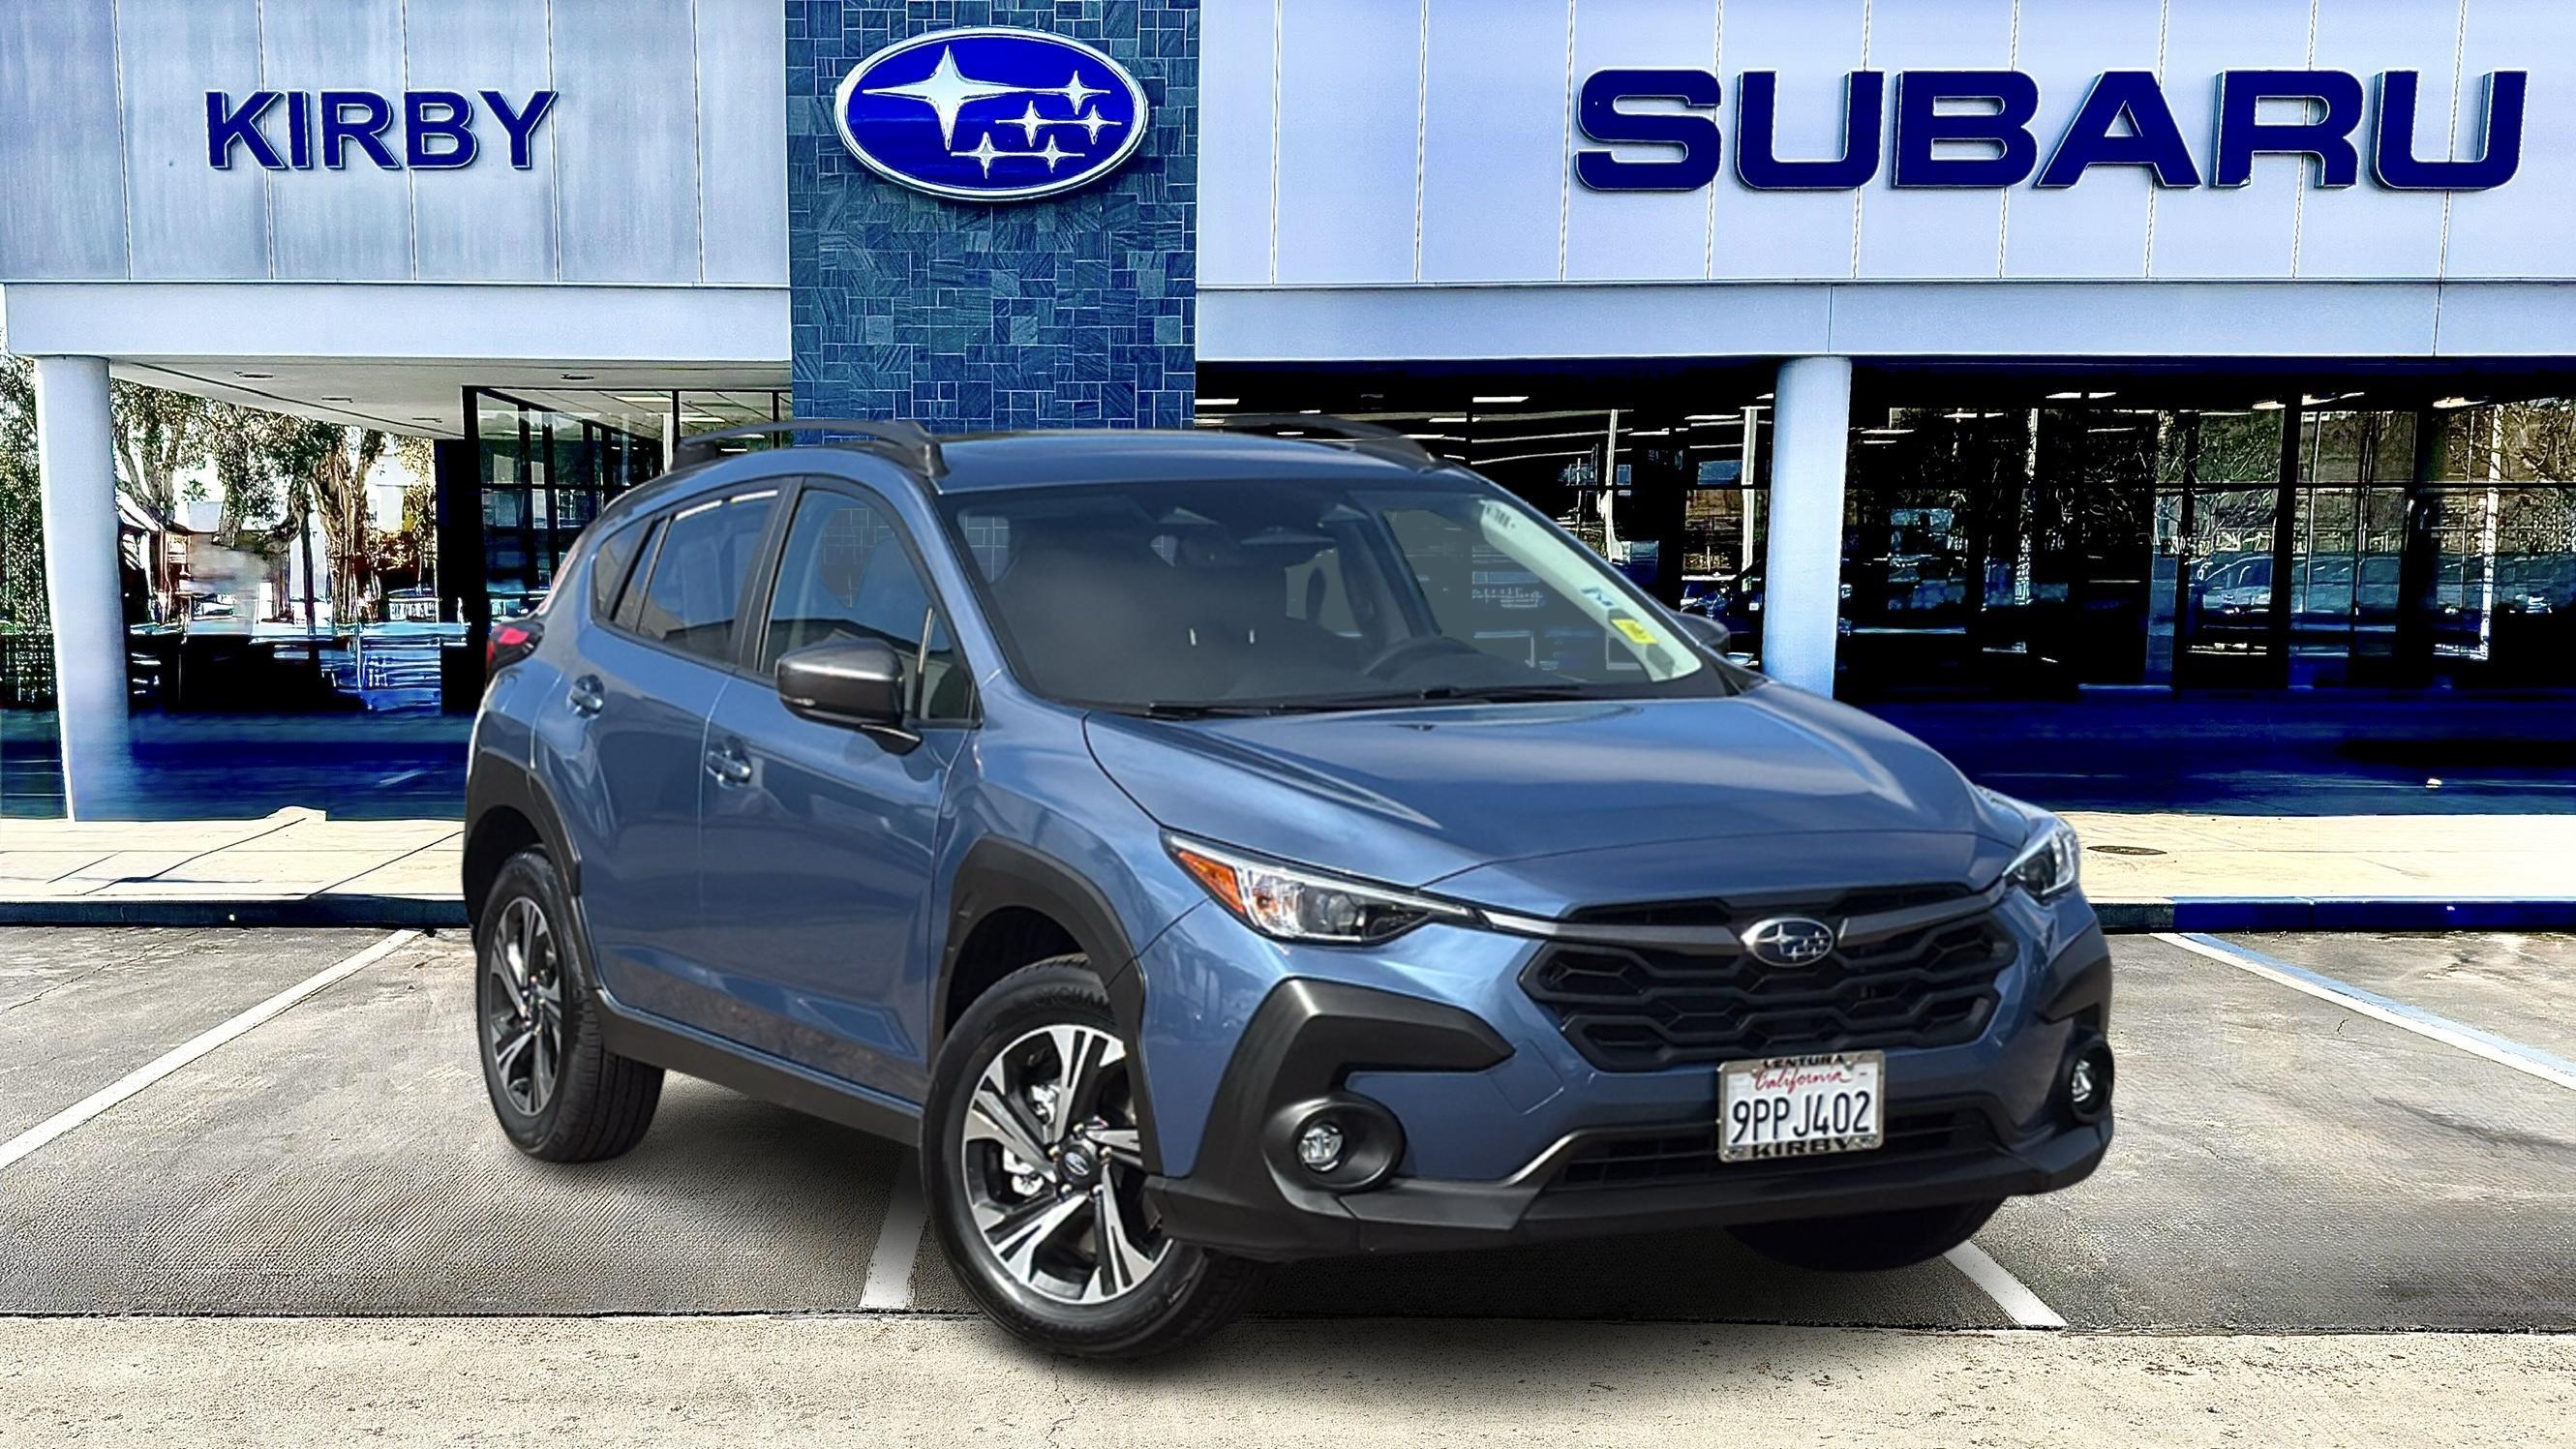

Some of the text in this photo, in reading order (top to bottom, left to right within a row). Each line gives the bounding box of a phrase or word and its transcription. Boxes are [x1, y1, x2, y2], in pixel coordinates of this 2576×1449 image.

[204, 90, 559, 170] KIRBY
[1575, 68, 2528, 192] SUBARU
[1755, 1068, 1851, 1094] California
[1732, 1090, 1870, 1143] 9PPJ402
[1751, 1137, 1851, 1157] KIRBY
